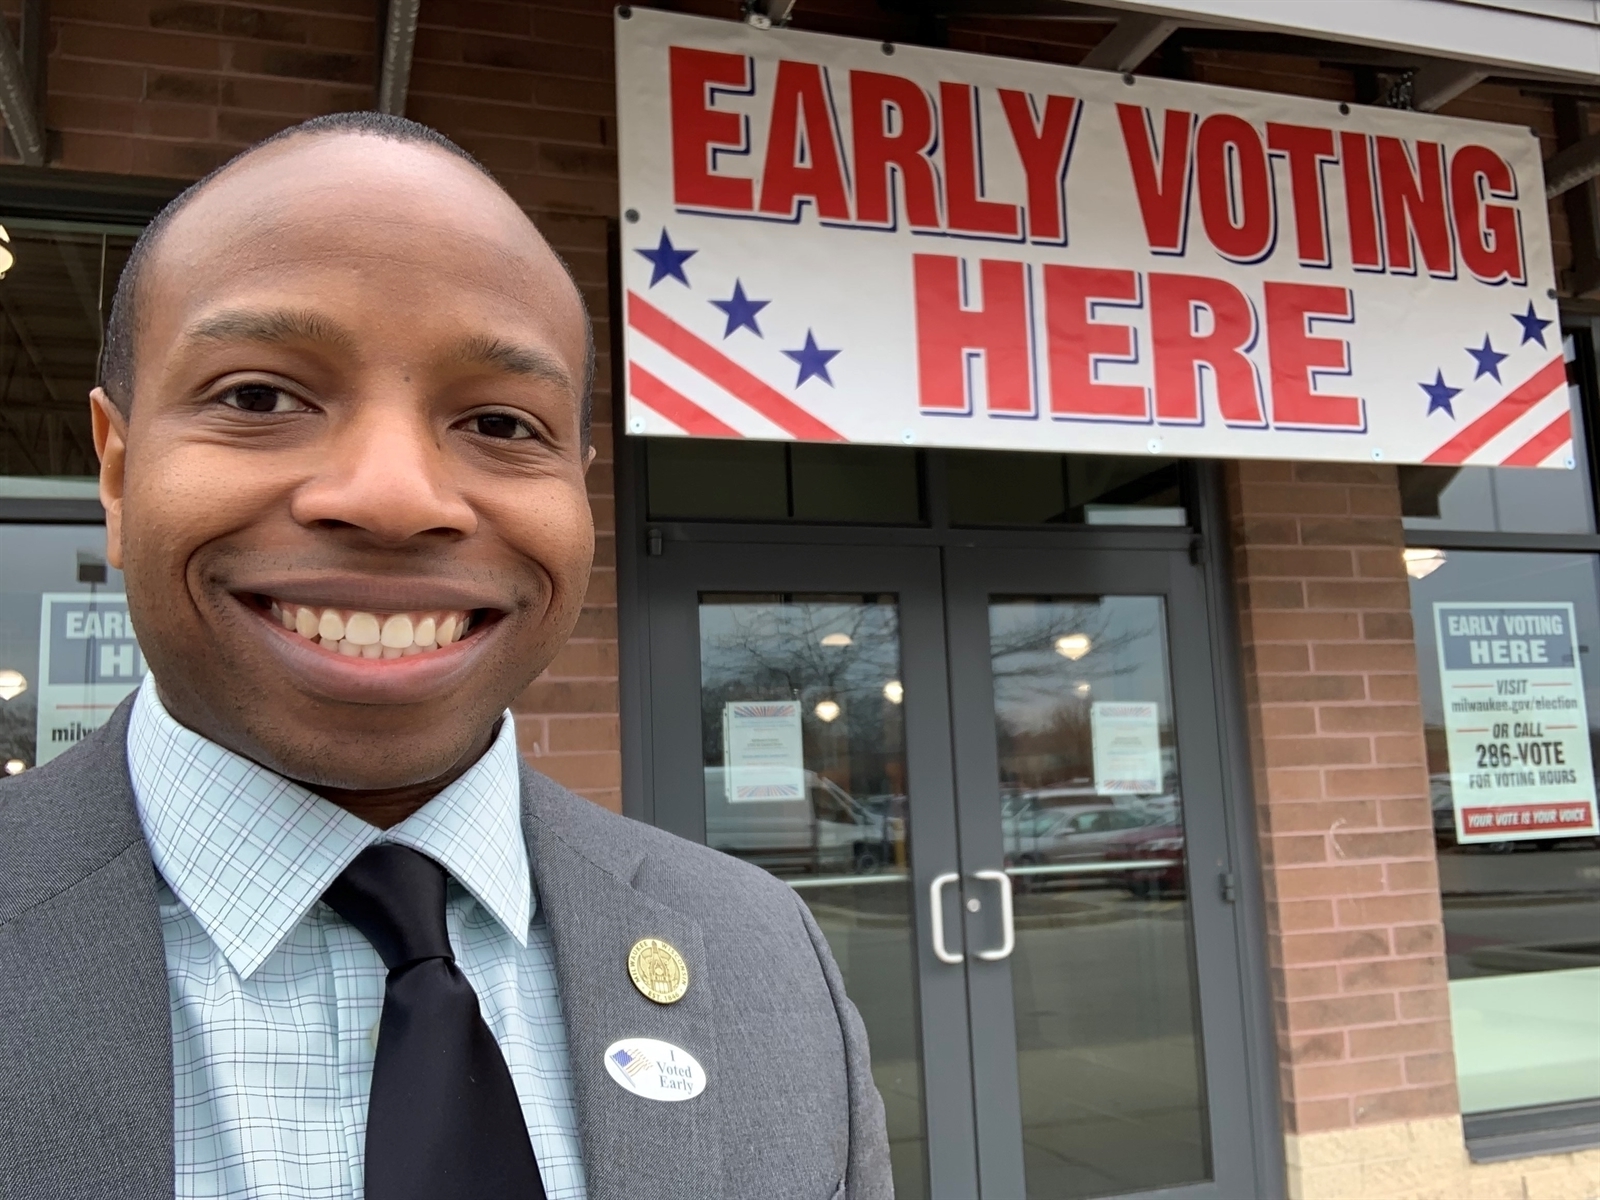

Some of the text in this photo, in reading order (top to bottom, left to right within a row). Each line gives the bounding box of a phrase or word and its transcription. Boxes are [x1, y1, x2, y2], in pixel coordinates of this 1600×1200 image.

[669, 45, 1527, 286] EARLY VOTING
[912, 253, 1367, 433] HERE
[1448, 614, 1564, 636] EARLY VOTING
[1469, 639, 1549, 665] HERE
[1496, 679, 1529, 695] VISIT
[1451, 696, 1578, 714] milwaukee.gov/election
[1493, 722, 1544, 739] OR CALL
[1476, 741, 1565, 768] 286-VOTE
[1469, 770, 1577, 789] FOR VOTING HOURS
[1468, 813, 1493, 828] YOUR
[1495, 811, 1519, 826] VOTE
[1521, 811, 1531, 825] IS
[1532, 809, 1558, 824] YOUR
[629, 941, 648, 983] MILWAUKEE
[661, 942, 687, 986] WISCONSIN
[664, 992, 680, 1002] 1846
[670, 1050, 675, 1062] I
[656, 1061, 692, 1078] Voted
[659, 1075, 693, 1095] Early
